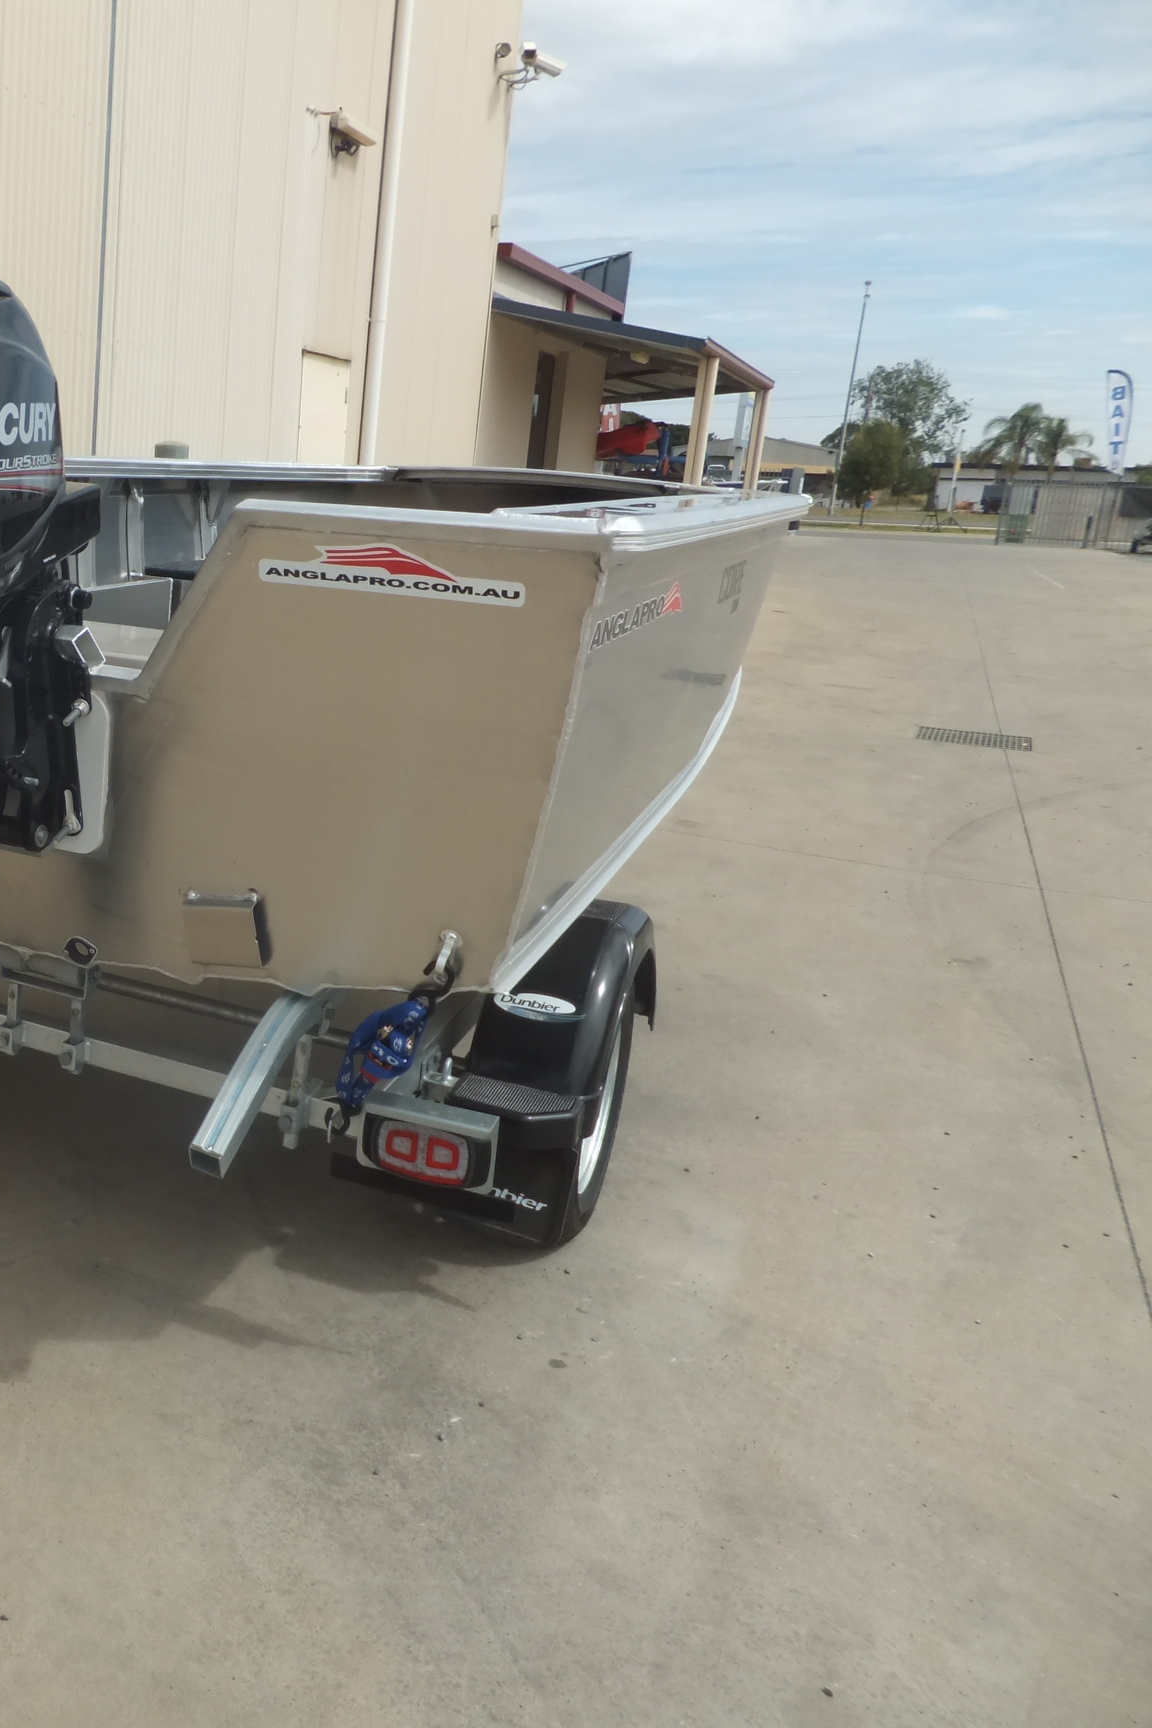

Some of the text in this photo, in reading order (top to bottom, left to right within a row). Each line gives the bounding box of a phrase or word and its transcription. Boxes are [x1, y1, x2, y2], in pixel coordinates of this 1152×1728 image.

[265, 566, 521, 600] ANGLAPRO.COM.AU
[588, 595, 665, 652] ANGLAPRO
[500, 994, 560, 1012] Dunbier
